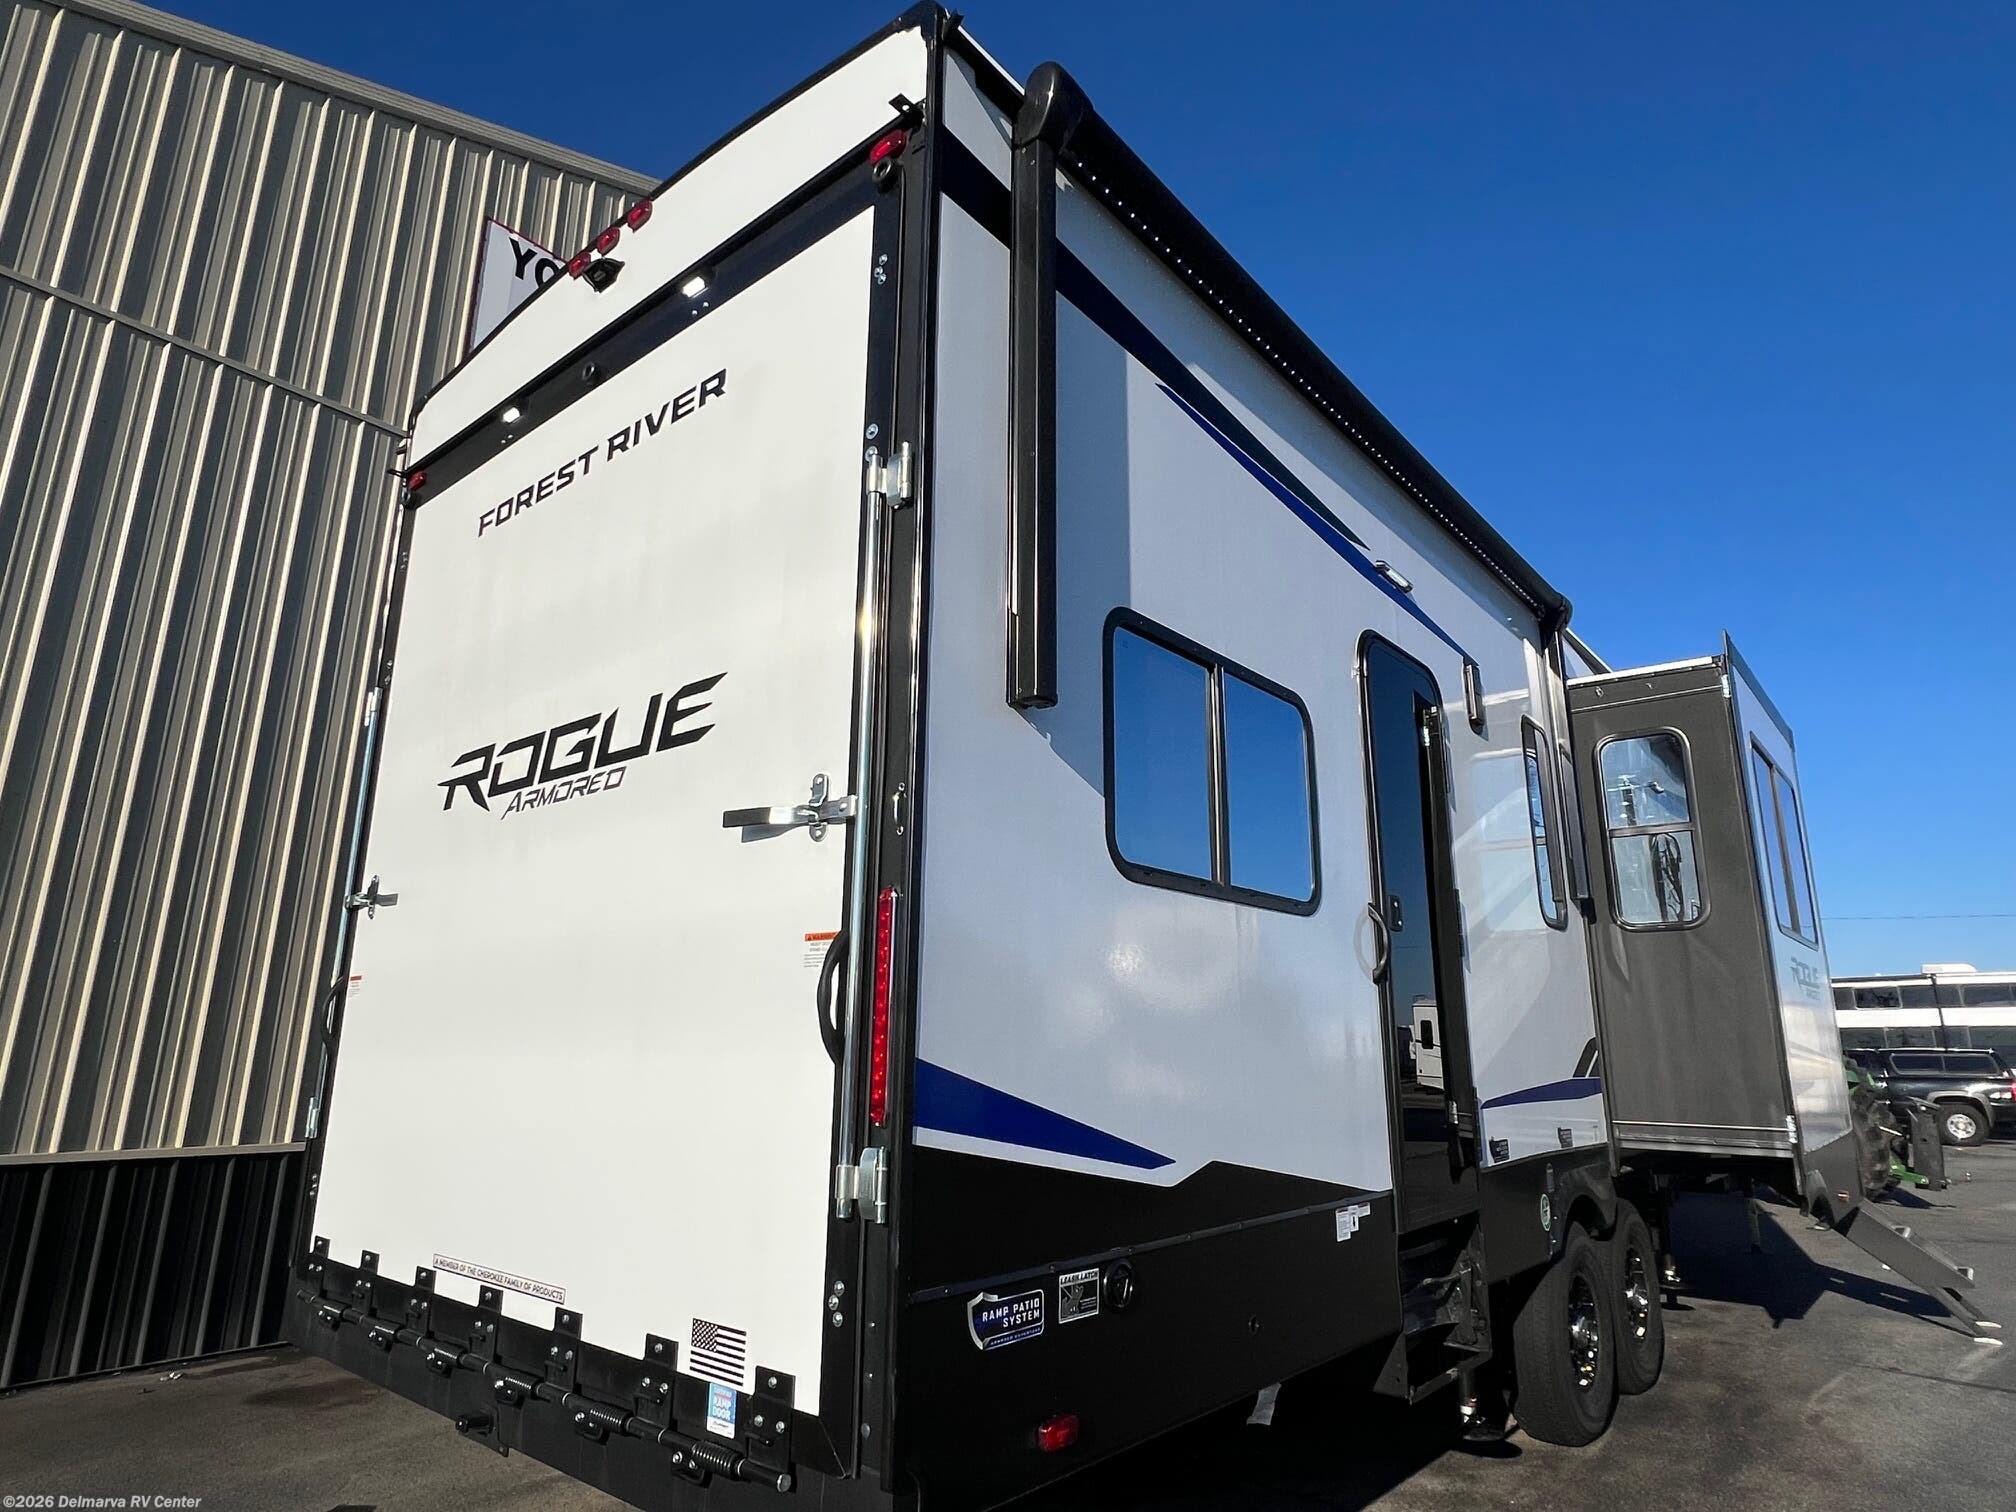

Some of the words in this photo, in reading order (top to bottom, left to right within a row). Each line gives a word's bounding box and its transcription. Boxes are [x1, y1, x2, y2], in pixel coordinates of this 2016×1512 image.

[478, 445, 599, 538] FOREST
[606, 368, 727, 462] RIVER
[437, 672, 728, 812] ROGUE
[501, 766, 627, 820] ARMORED
[440, 1259, 458, 1270] MEMBER
[460, 1264, 467, 1273] OF
[467, 1266, 477, 1276] THE
[477, 1268, 504, 1283] CHEROKEE
[504, 1276, 523, 1289] FAMILY
[524, 1281, 533, 1292] OF
[533, 1284, 563, 1300] PRODUCTS
[982, 1306, 1009, 1322] RAMP
[1013, 1297, 1040, 1314] PATIO
[1002, 1308, 1040, 1328] SYSTEM
